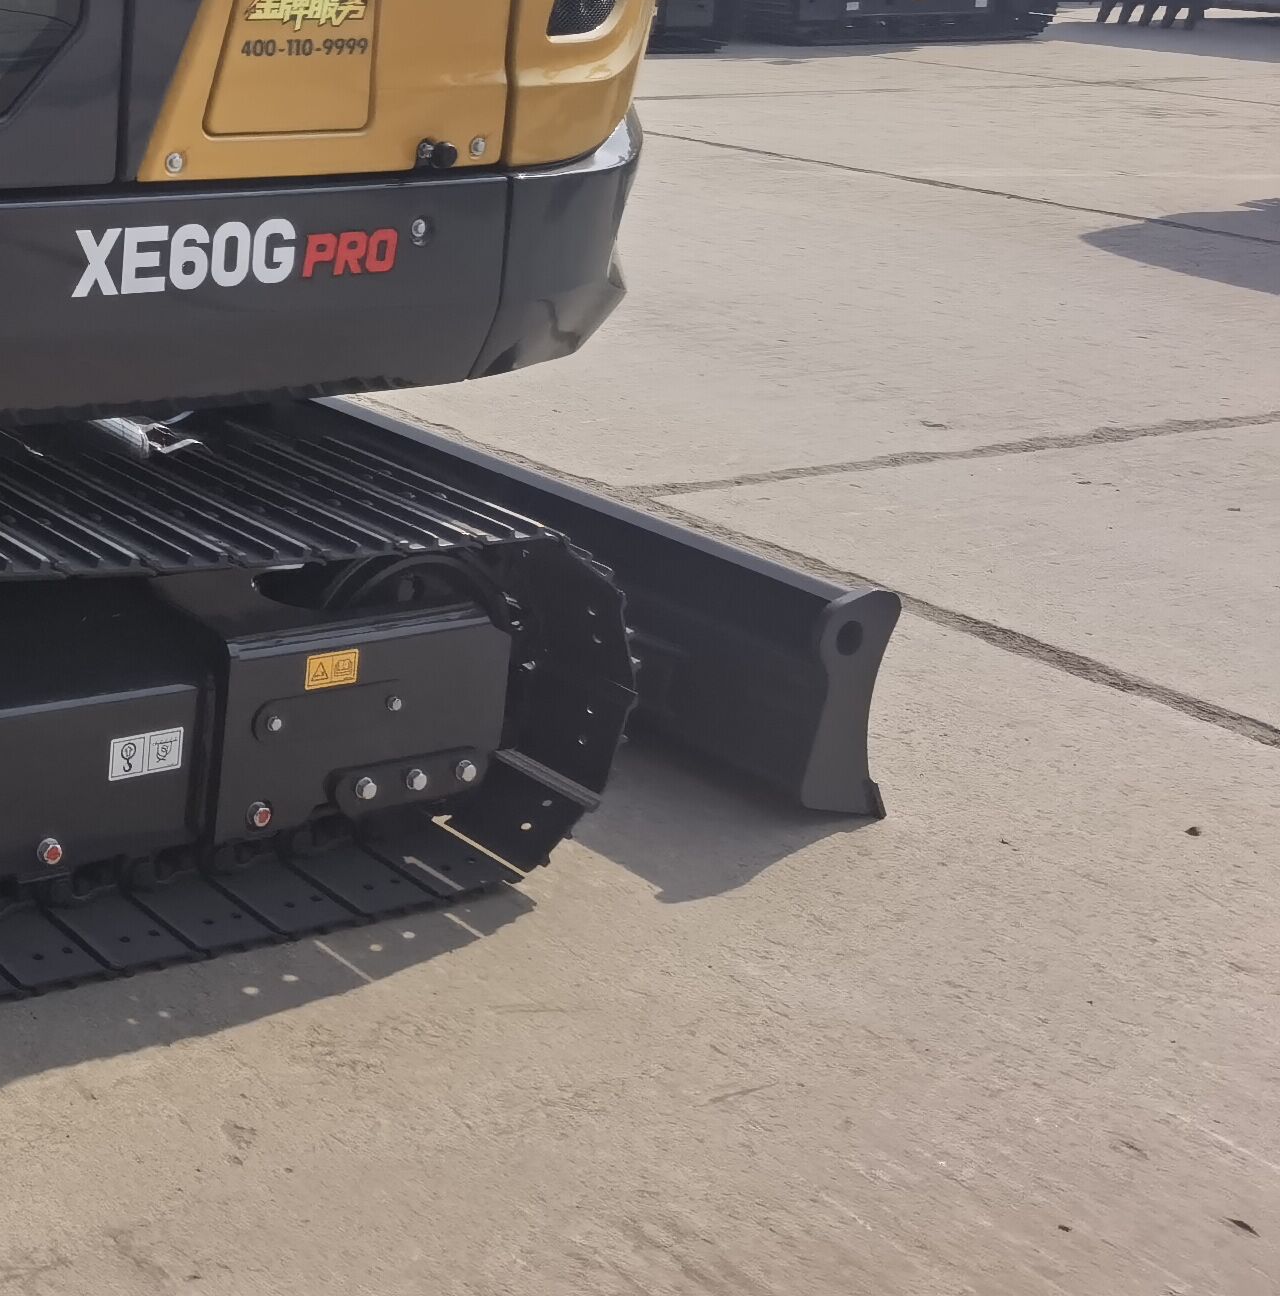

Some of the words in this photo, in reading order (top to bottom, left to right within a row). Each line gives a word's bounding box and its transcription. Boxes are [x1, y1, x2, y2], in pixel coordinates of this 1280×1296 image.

[241, 37, 369, 58] 400-110-9999
[71, 218, 296, 298] XE60G
[301, 228, 399, 279] PRO
